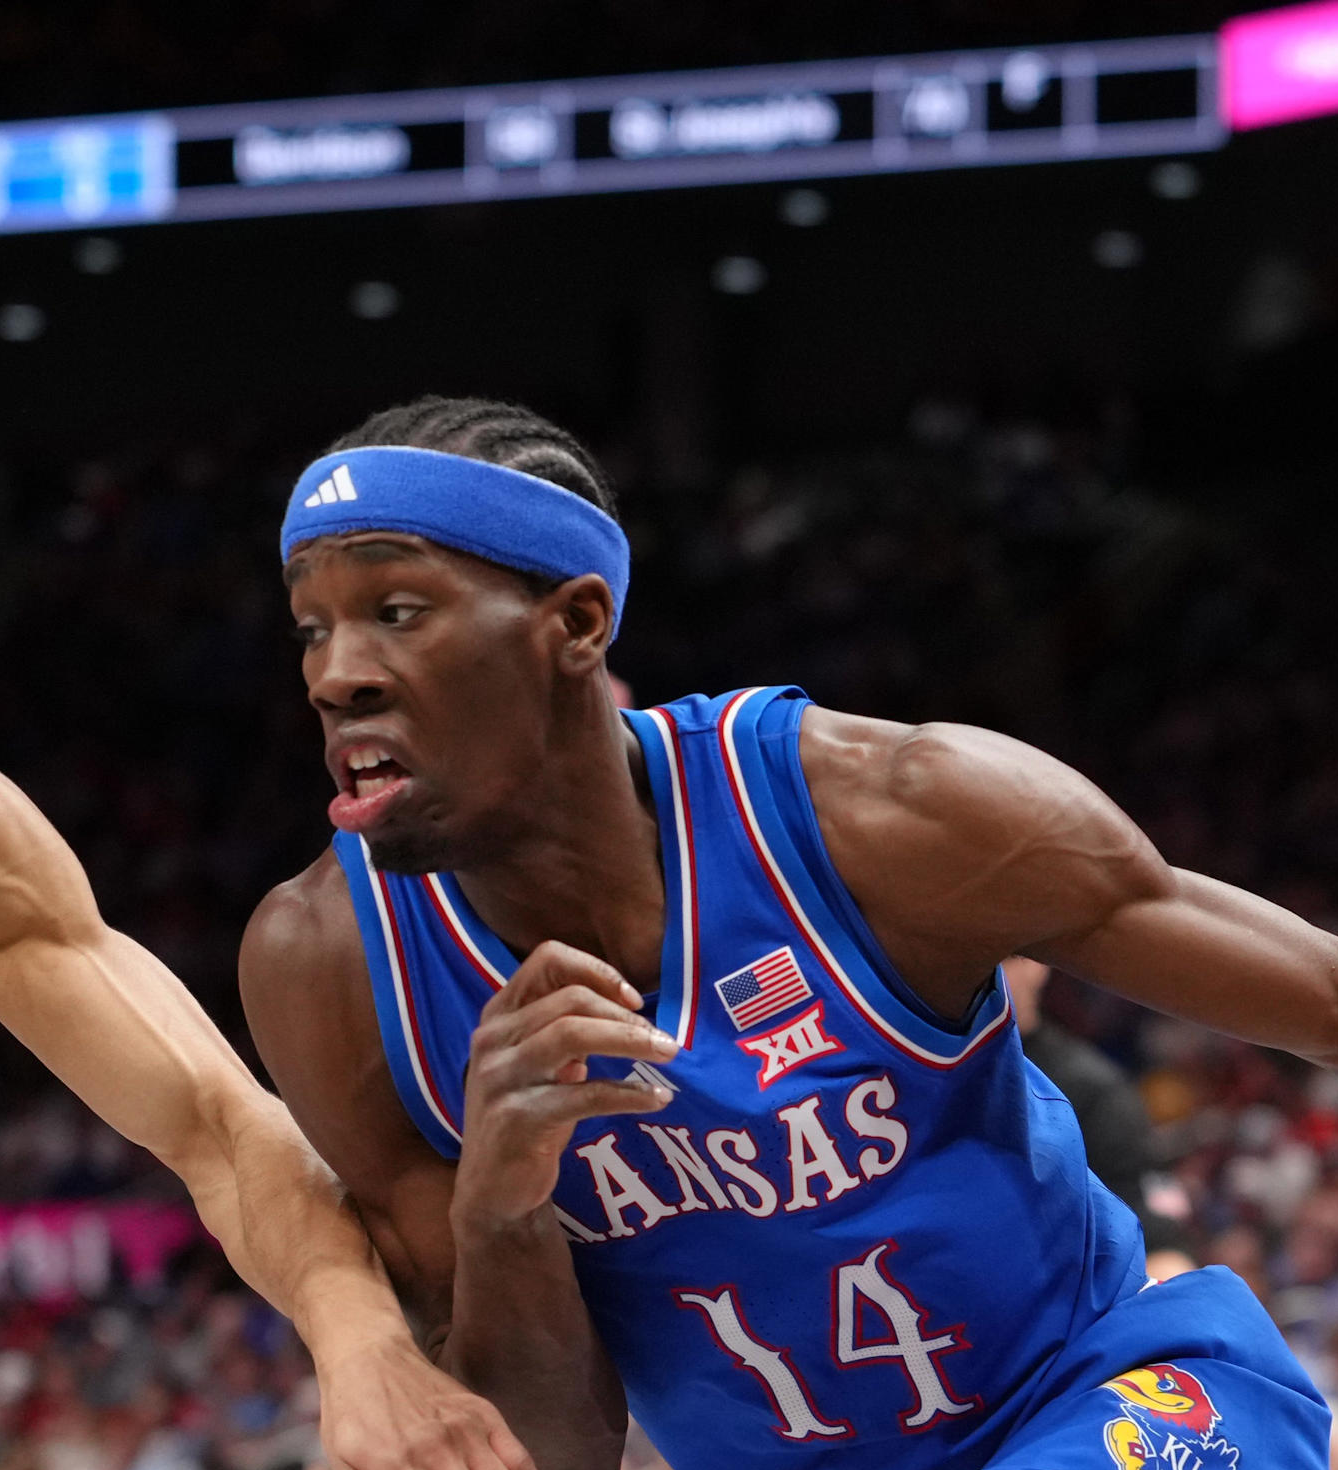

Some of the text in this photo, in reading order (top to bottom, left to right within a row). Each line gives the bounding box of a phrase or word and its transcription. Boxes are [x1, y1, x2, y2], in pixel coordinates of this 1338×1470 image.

[736, 999, 847, 1092] XII
[552, 1073, 909, 1245] ANSAS
[671, 1238, 984, 1441] 14
